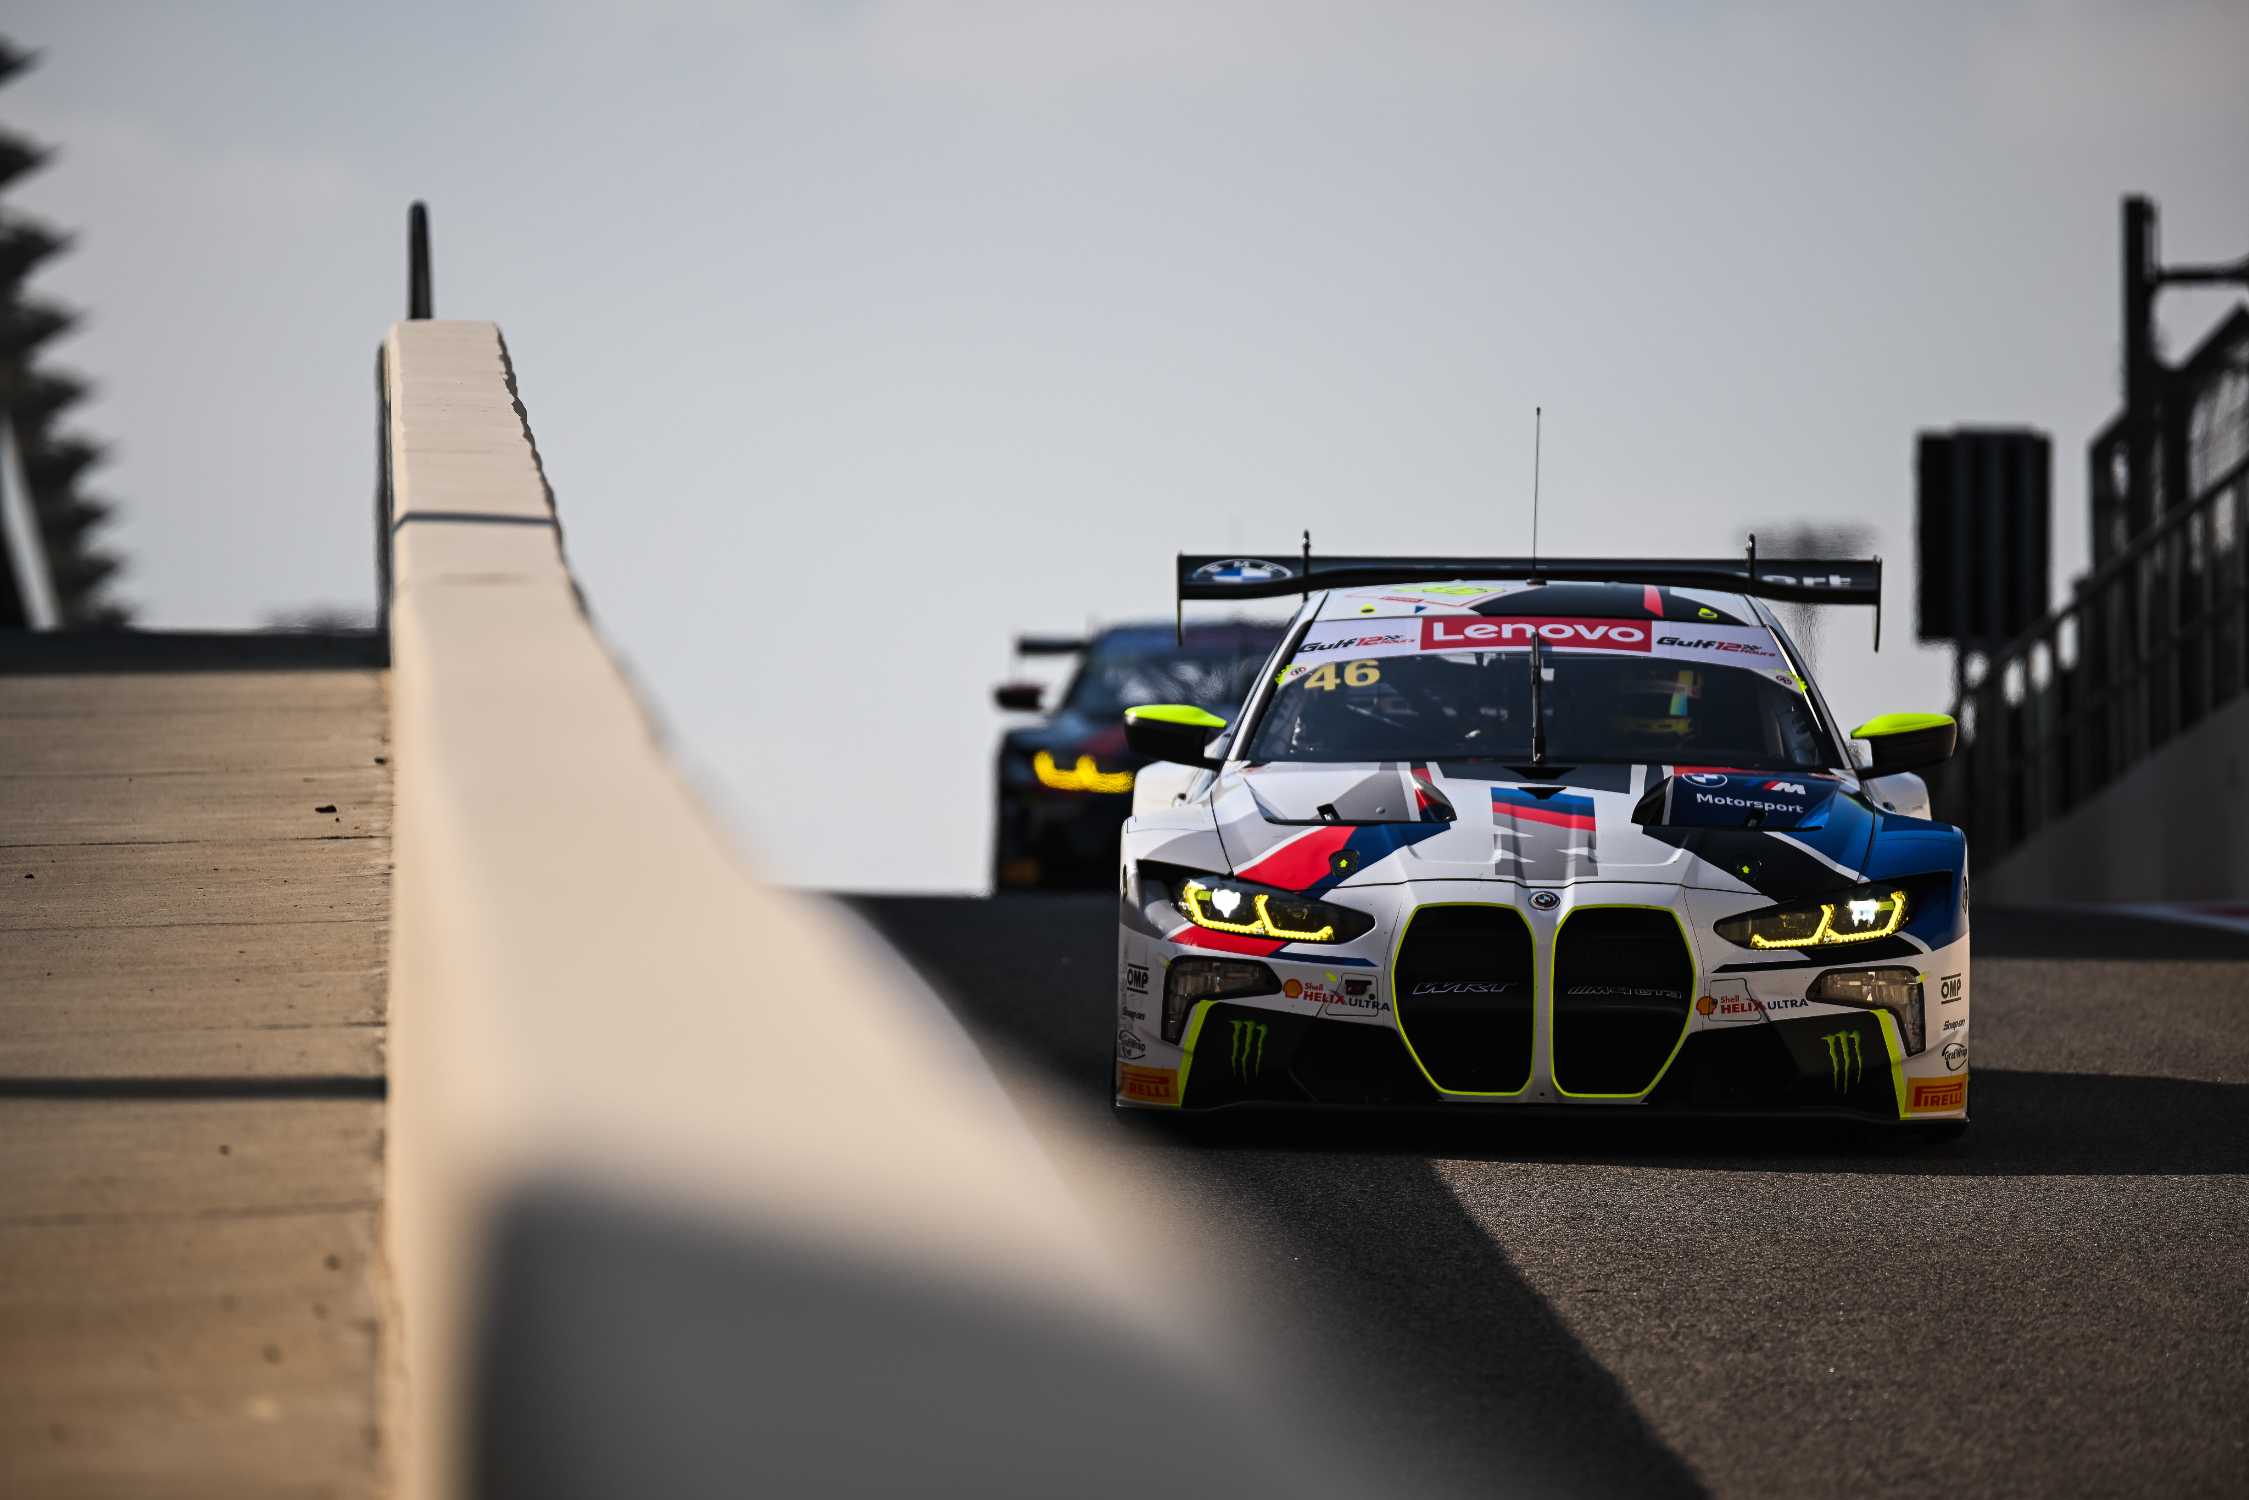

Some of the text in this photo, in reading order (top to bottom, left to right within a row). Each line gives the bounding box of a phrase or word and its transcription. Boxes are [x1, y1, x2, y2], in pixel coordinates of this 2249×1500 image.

[1432, 621, 1645, 643] Lenovo
[1304, 659, 1381, 691] 46
[1696, 793, 1804, 812] Motorsport
[1126, 968, 1149, 989] OMP
[1304, 982, 1324, 992] Shell
[1940, 978, 1962, 999] OMP
[1303, 991, 1391, 1012] HELIX ULTRA
[1720, 995, 1740, 1003] Shell
[1720, 998, 1809, 1014] HELIX ULTRA
[1913, 1082, 1963, 1108] PIRELLI
